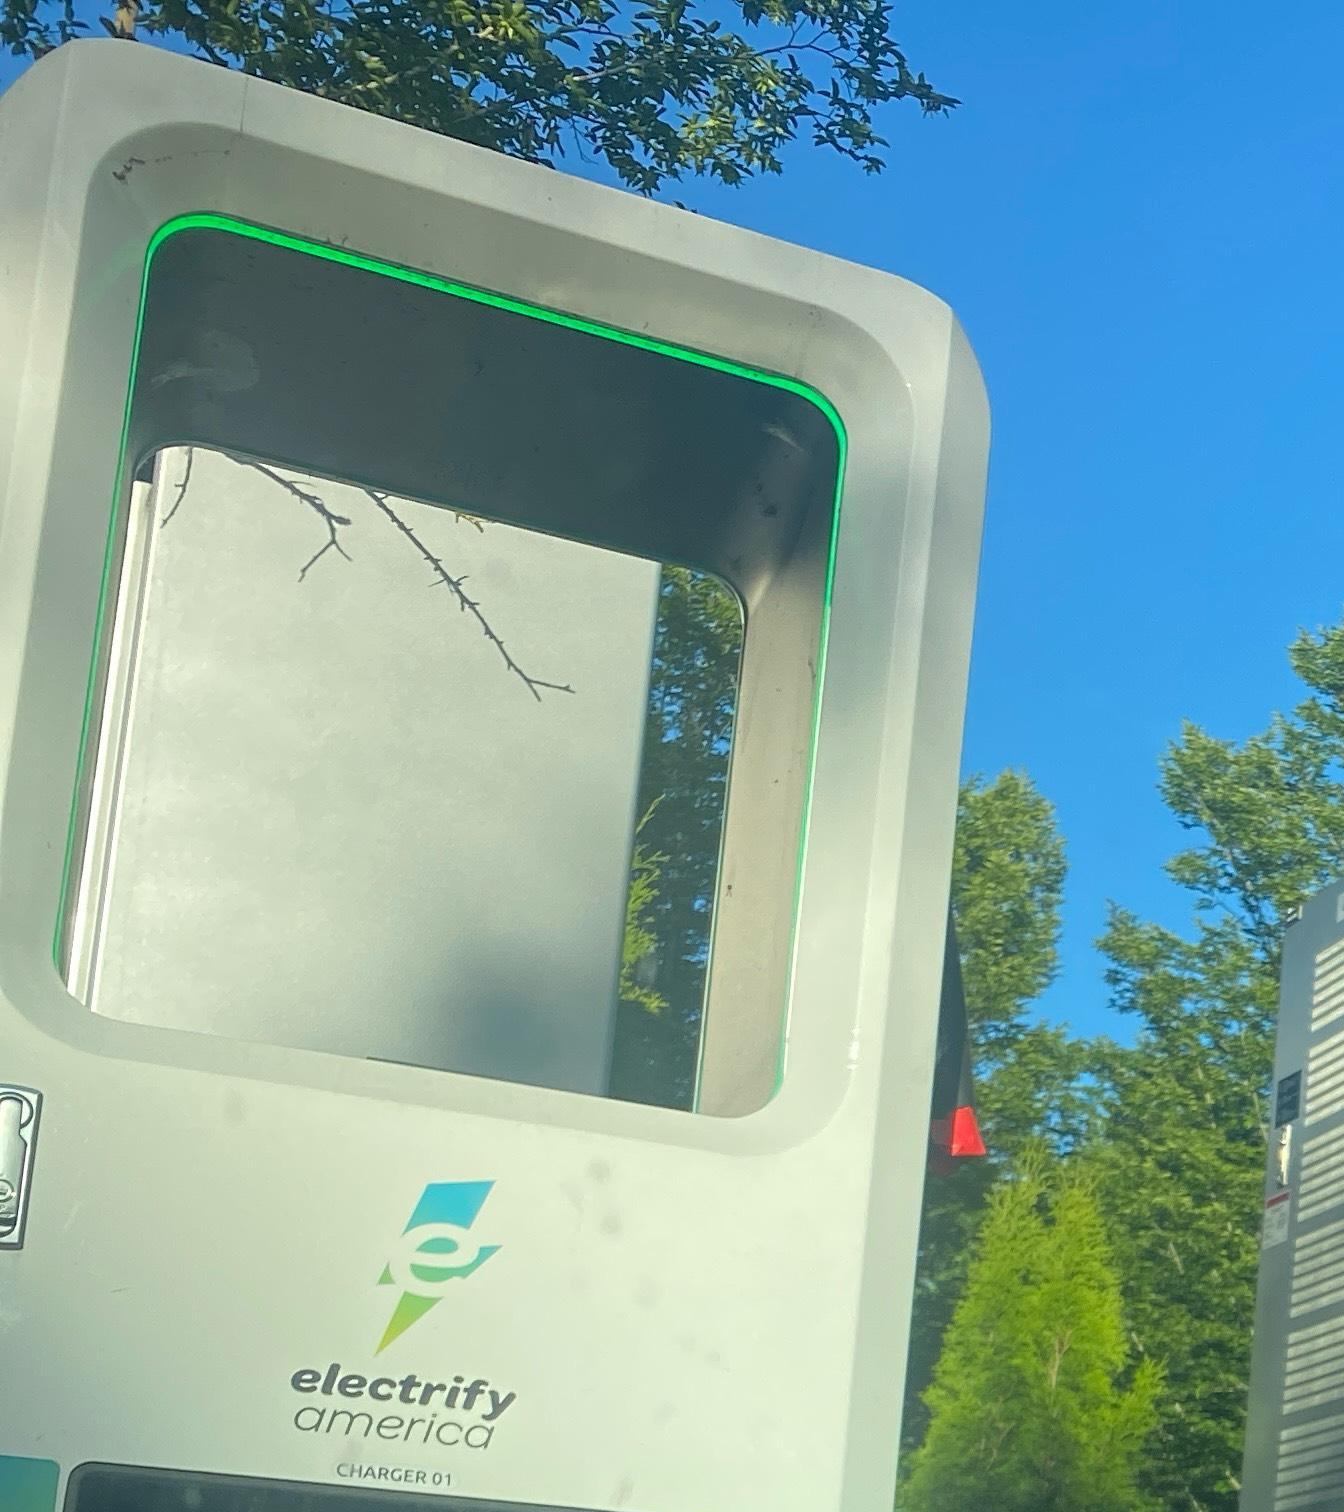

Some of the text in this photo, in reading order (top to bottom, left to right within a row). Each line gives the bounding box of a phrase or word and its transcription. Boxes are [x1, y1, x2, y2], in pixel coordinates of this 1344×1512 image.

[290, 1362, 517, 1422] electrify
[294, 1406, 495, 1450] america
[336, 1463, 453, 1487] CHARGER 01
